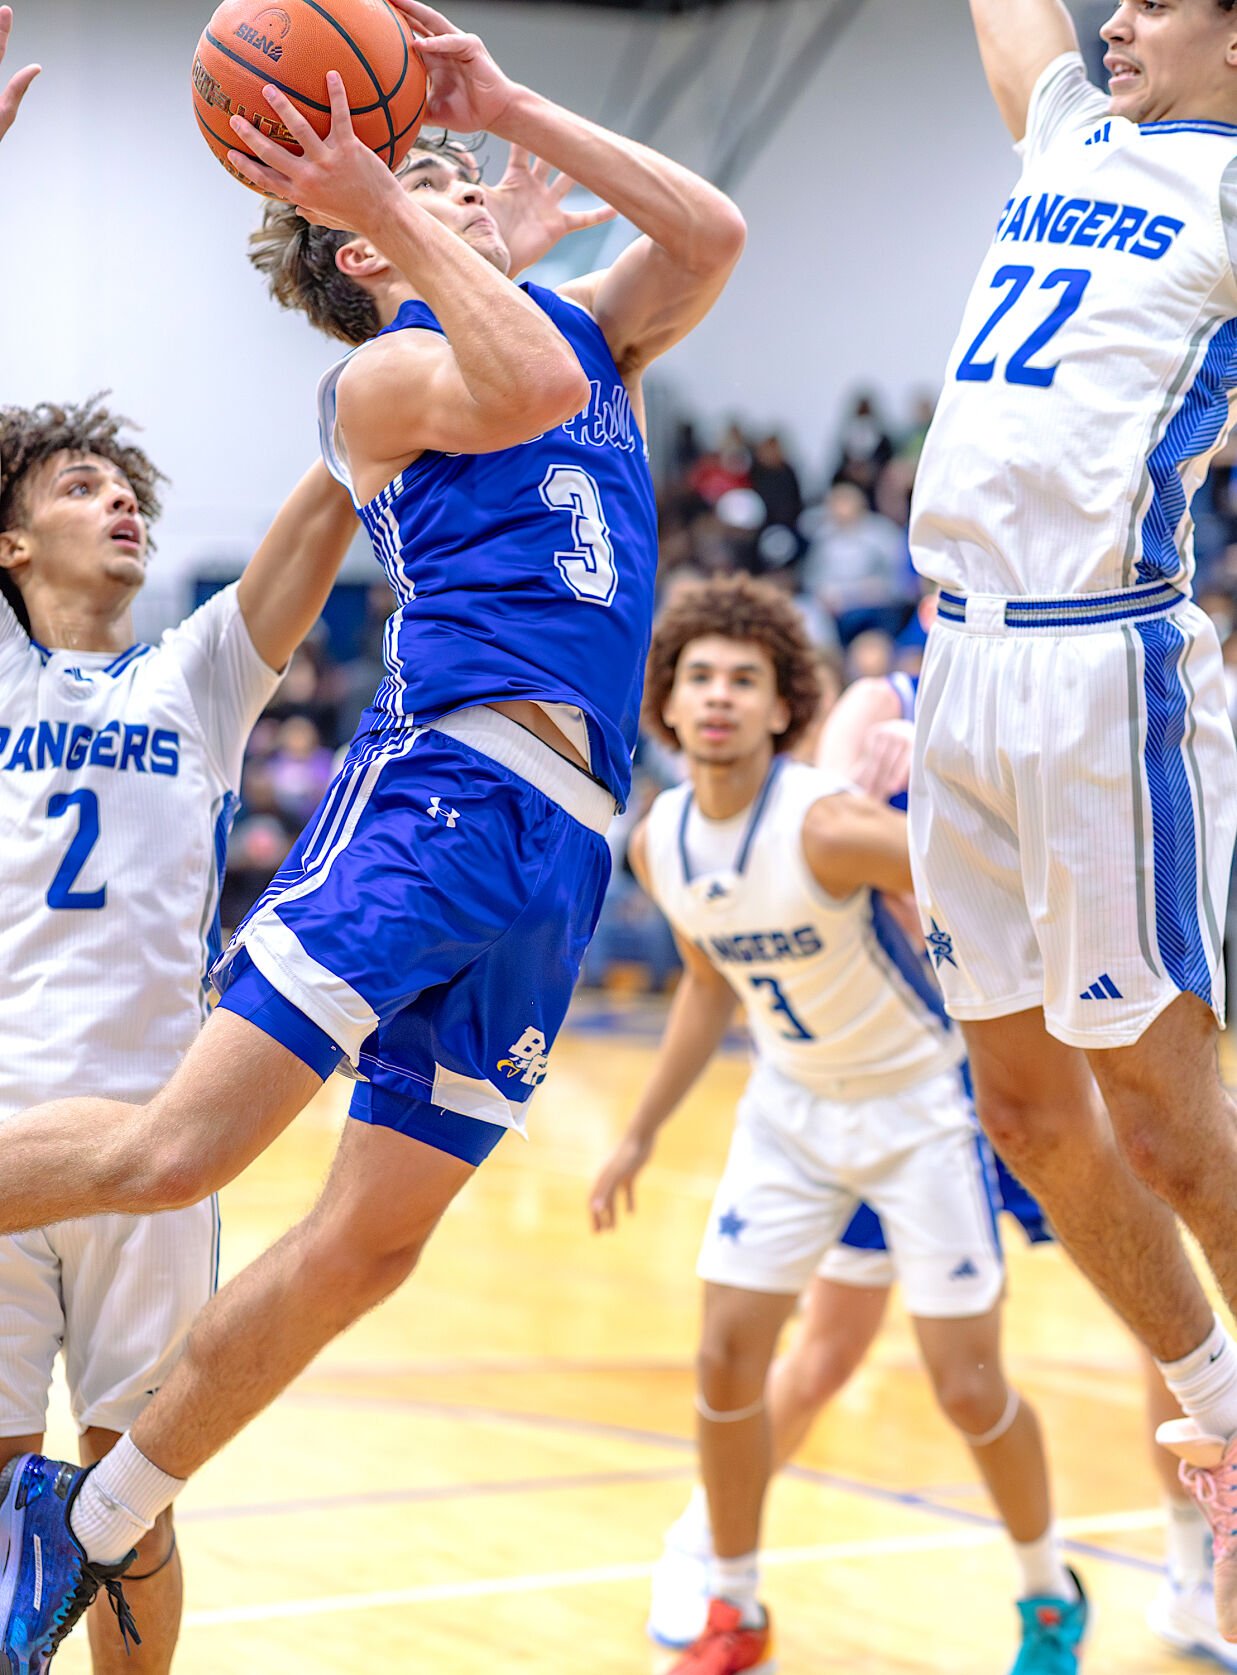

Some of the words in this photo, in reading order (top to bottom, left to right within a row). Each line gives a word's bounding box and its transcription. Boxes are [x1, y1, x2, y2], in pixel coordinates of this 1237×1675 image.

[234, 22, 275, 55] NFHS
[955, 265, 1092, 388] 22
[538, 463, 619, 608] 3
[46, 788, 108, 909] 2
[749, 975, 816, 1042] 3
